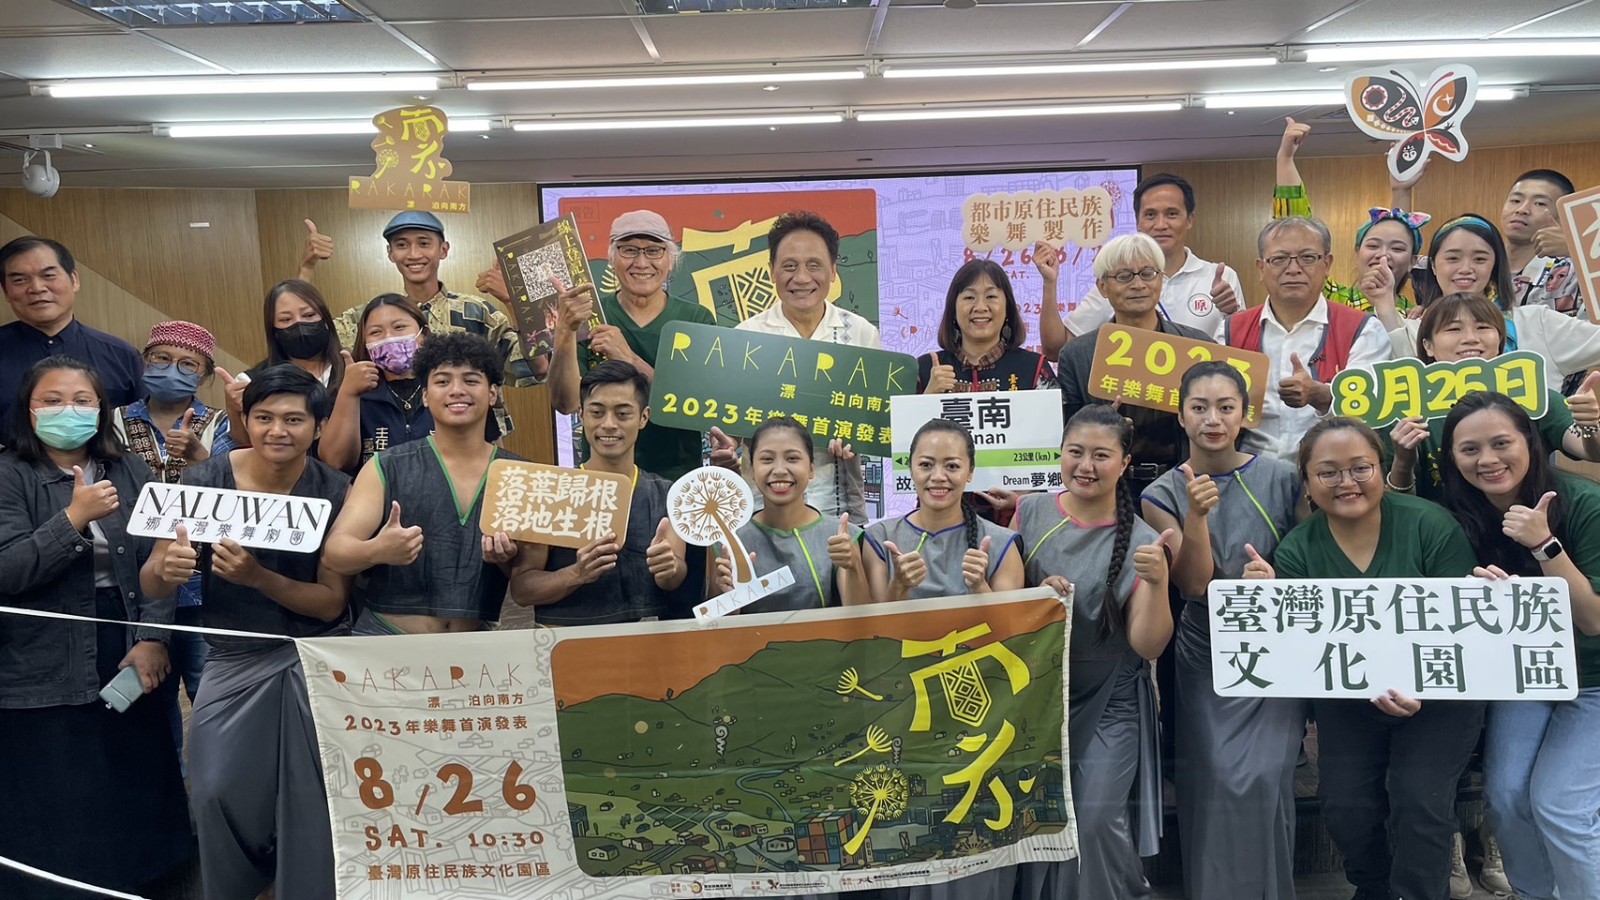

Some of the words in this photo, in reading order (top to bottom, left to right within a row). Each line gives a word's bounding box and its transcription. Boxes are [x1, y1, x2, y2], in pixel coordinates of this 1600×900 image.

[351, 180, 467, 199] RAKARAK
[431, 201, 467, 211] 泊向南方
[970, 195, 1103, 223] 都市原住民族
[969, 218, 1103, 244] 樂舞製作
[670, 332, 905, 391] RAKARAK
[780, 384, 797, 399] 漂
[1339, 358, 1538, 419] 8月26日
[940, 396, 1011, 430] 臺南
[496, 466, 618, 511] 落葉歸根
[139, 487, 326, 531] NALUWAN
[490, 497, 613, 540] 落地生根
[1216, 584, 1565, 635] 臺灣原住民族
[332, 663, 522, 693] RAKARAK
[1219, 641, 1569, 694] 文化園區
[427, 696, 440, 708] 漂
[468, 693, 524, 707] 泊向南方
[344, 715, 528, 735] 2023年樂舞首演發表
[354, 757, 537, 816] 8/26
[365, 825, 443, 851] SAT.
[468, 831, 544, 848] 10:30
[367, 862, 551, 881] 臺灣原住民族文化園區
